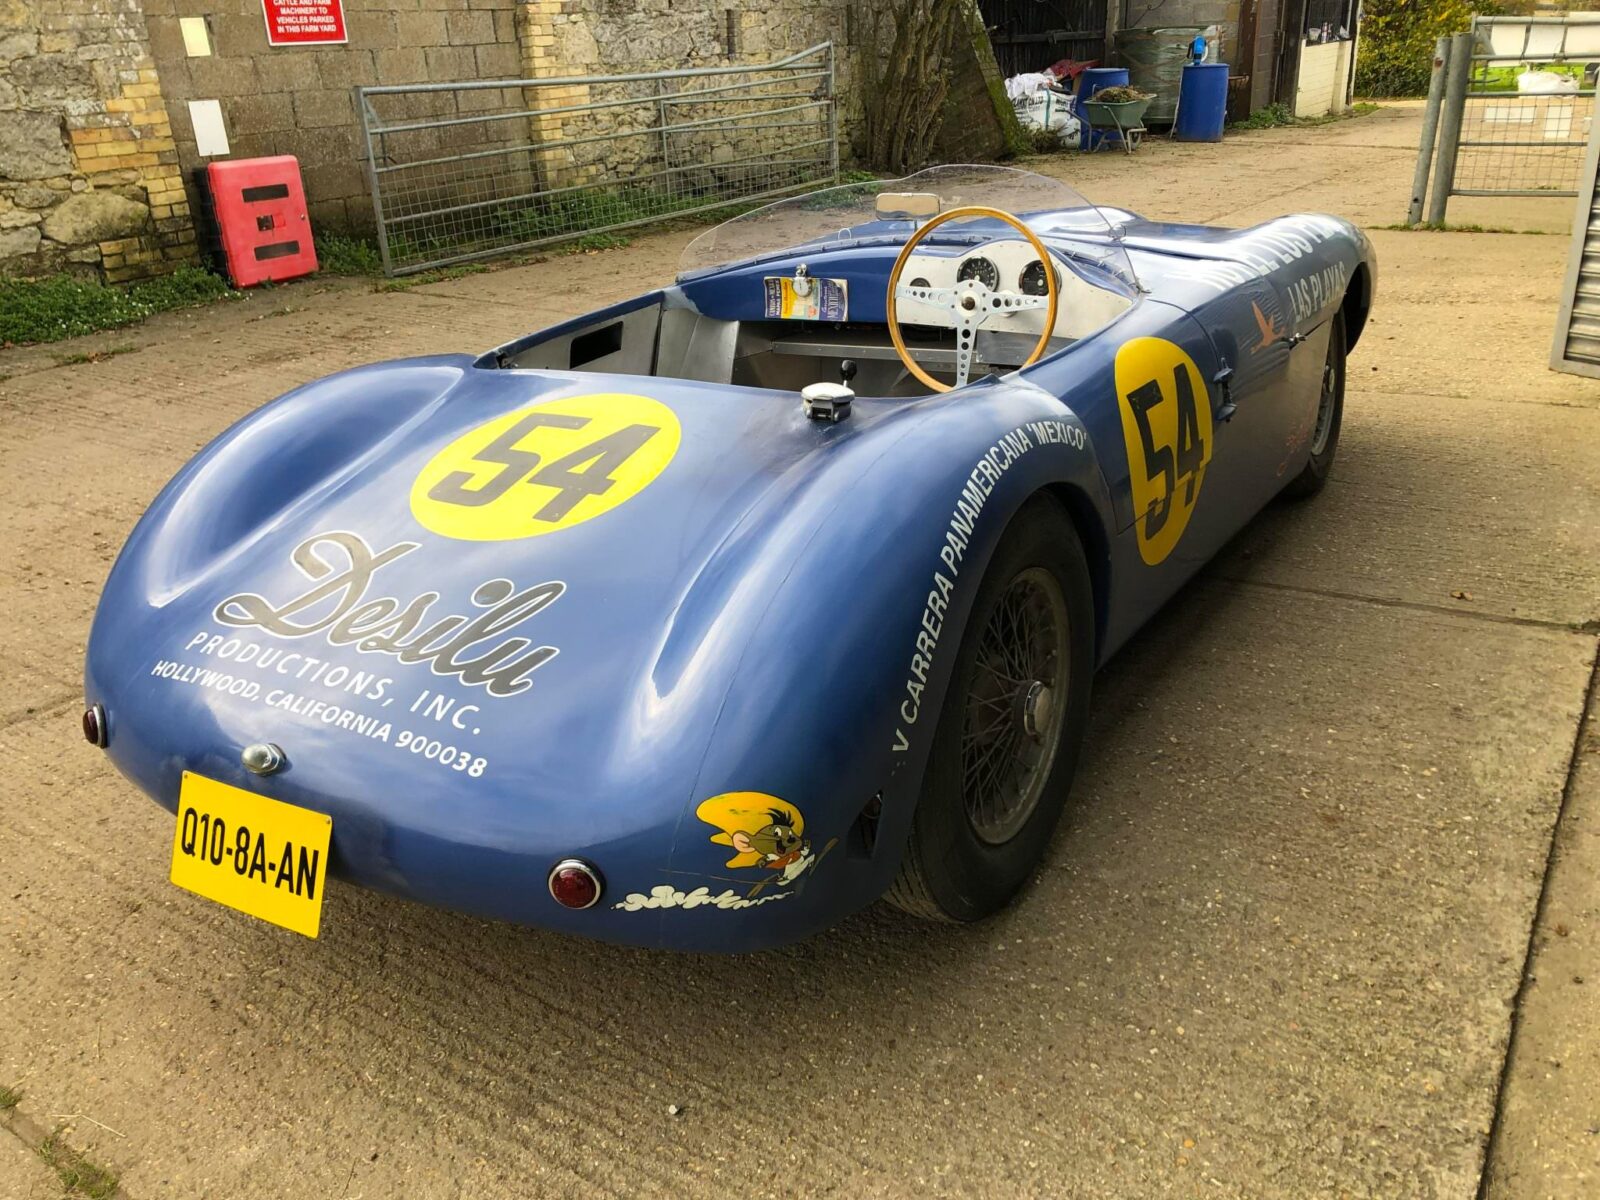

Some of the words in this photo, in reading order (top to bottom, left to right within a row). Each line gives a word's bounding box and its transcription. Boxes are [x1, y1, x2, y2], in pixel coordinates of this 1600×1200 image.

[276, 16, 308, 24] VEHICLES
[277, 25, 285, 33] IN
[285, 25, 300, 33] THIS
[320, 24, 337, 32] YARD
[280, 7, 317, 15] MACHINERY
[318, 7, 328, 15] TO
[1287, 278, 1312, 323] LAS
[1309, 261, 1346, 312] PLAYAS
[427, 412, 662, 523] 54
[1126, 362, 1204, 541] 54
[212, 530, 567, 698] Desilu
[900, 571, 954, 724] CARRERA
[940, 427, 1034, 577] PANAMERICANA
[151, 660, 261, 702] HOLLYWOOD,
[264, 689, 392, 743] CALIFORNIA
[394, 730, 488, 778] 900038
[185, 631, 395, 708] PRODUCTIONS,
[410, 690, 482, 735] INC.
[181, 807, 320, 900] Q10-8A-AN
